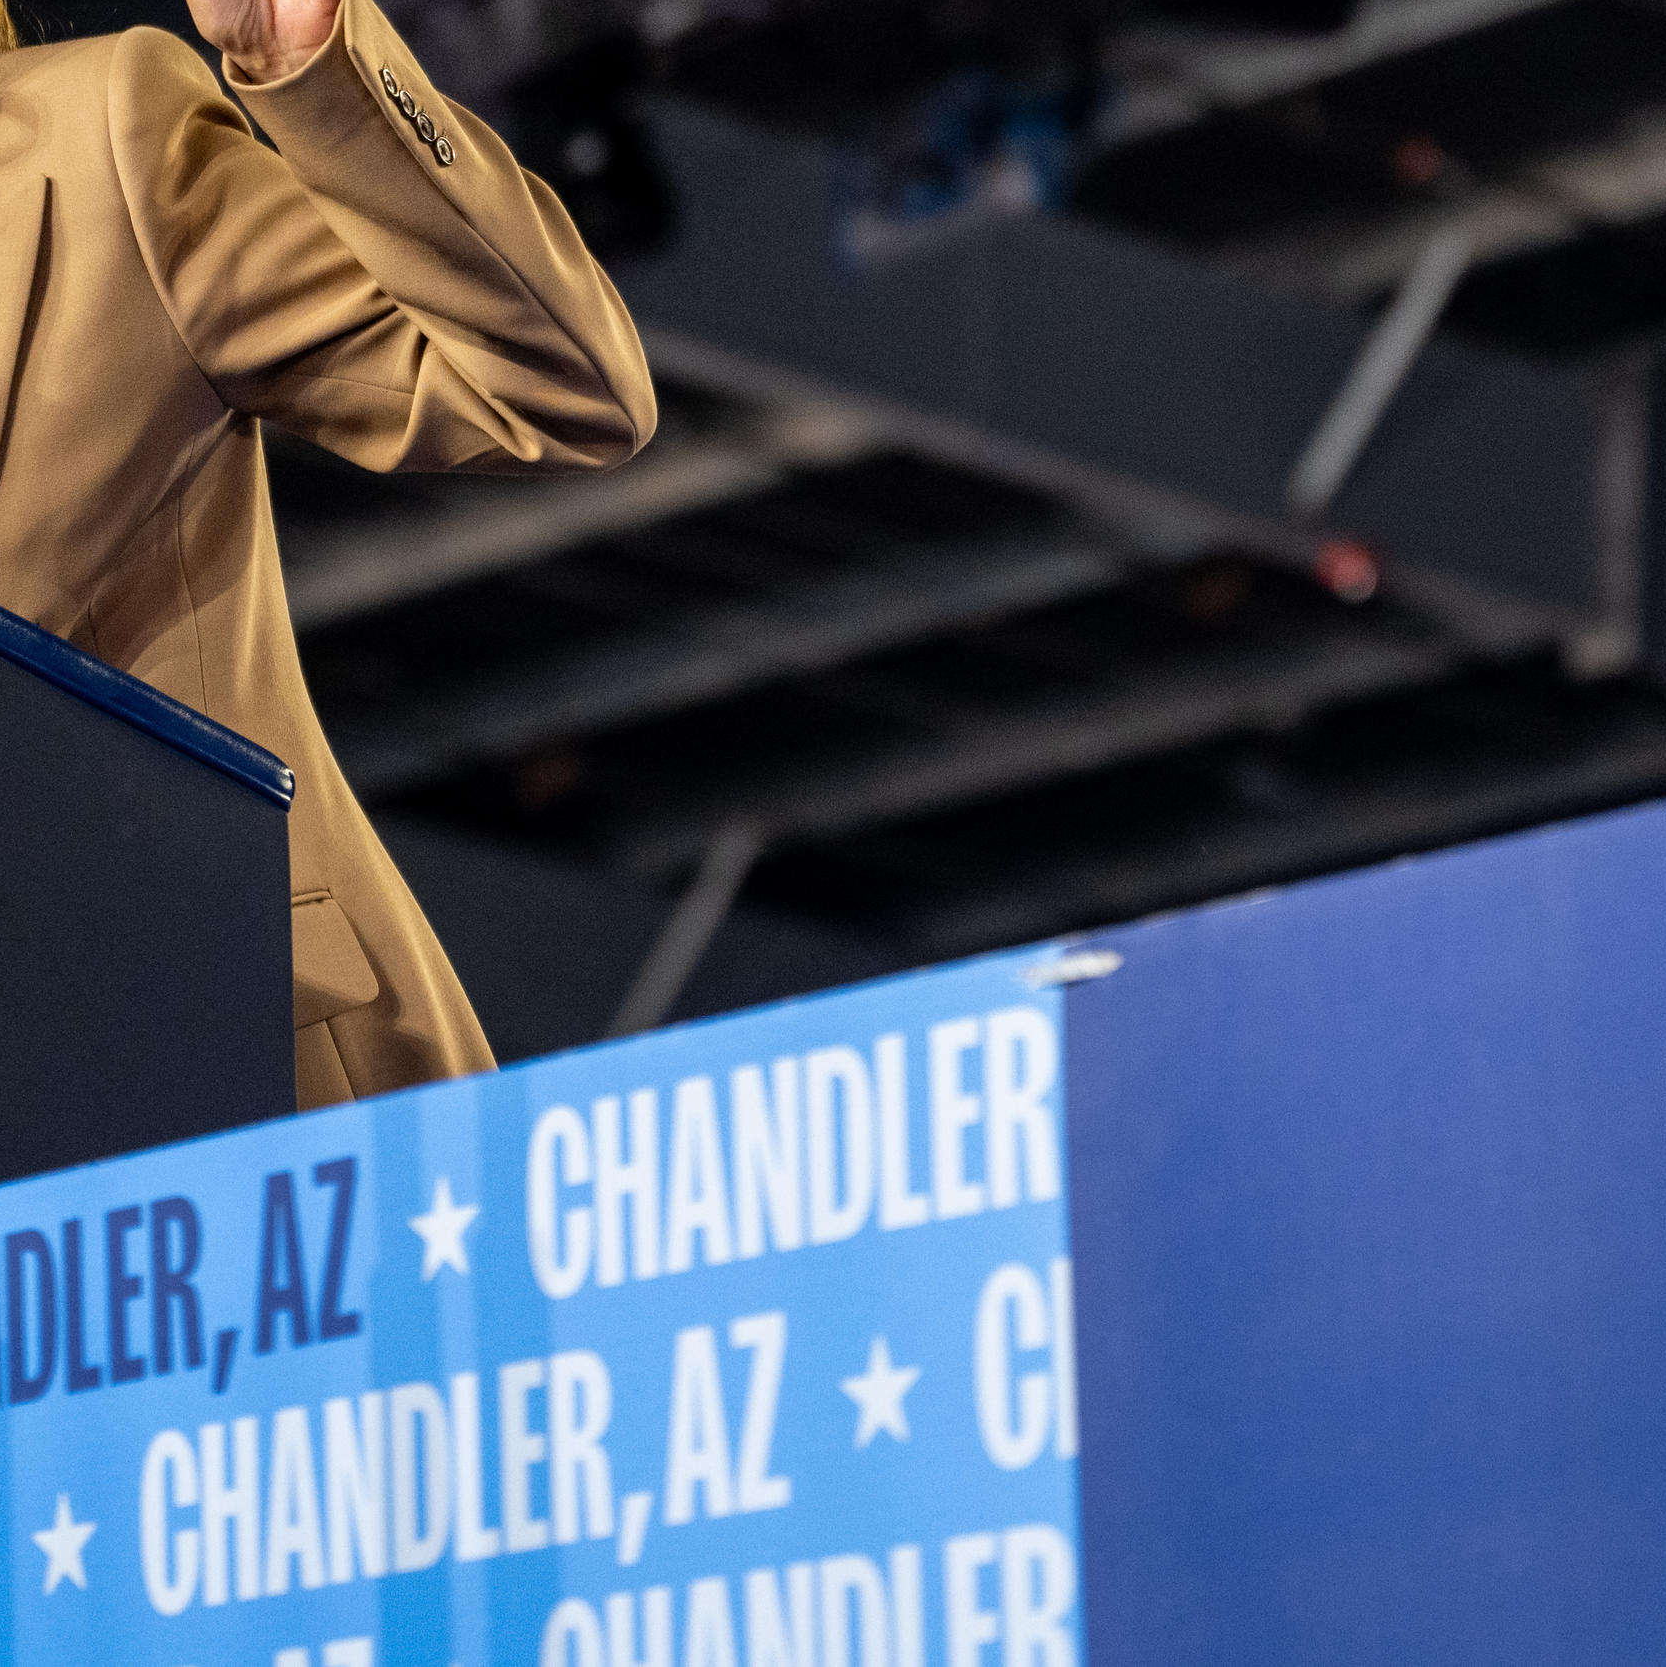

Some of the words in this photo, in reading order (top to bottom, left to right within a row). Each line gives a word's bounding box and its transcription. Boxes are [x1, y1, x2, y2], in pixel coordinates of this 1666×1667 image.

[252, 1155, 362, 1357] AZ
[526, 1006, 1061, 1299] CHANDLER
[138, 1349, 653, 1617] CHANDLER,
[663, 1311, 793, 1527] AZ
